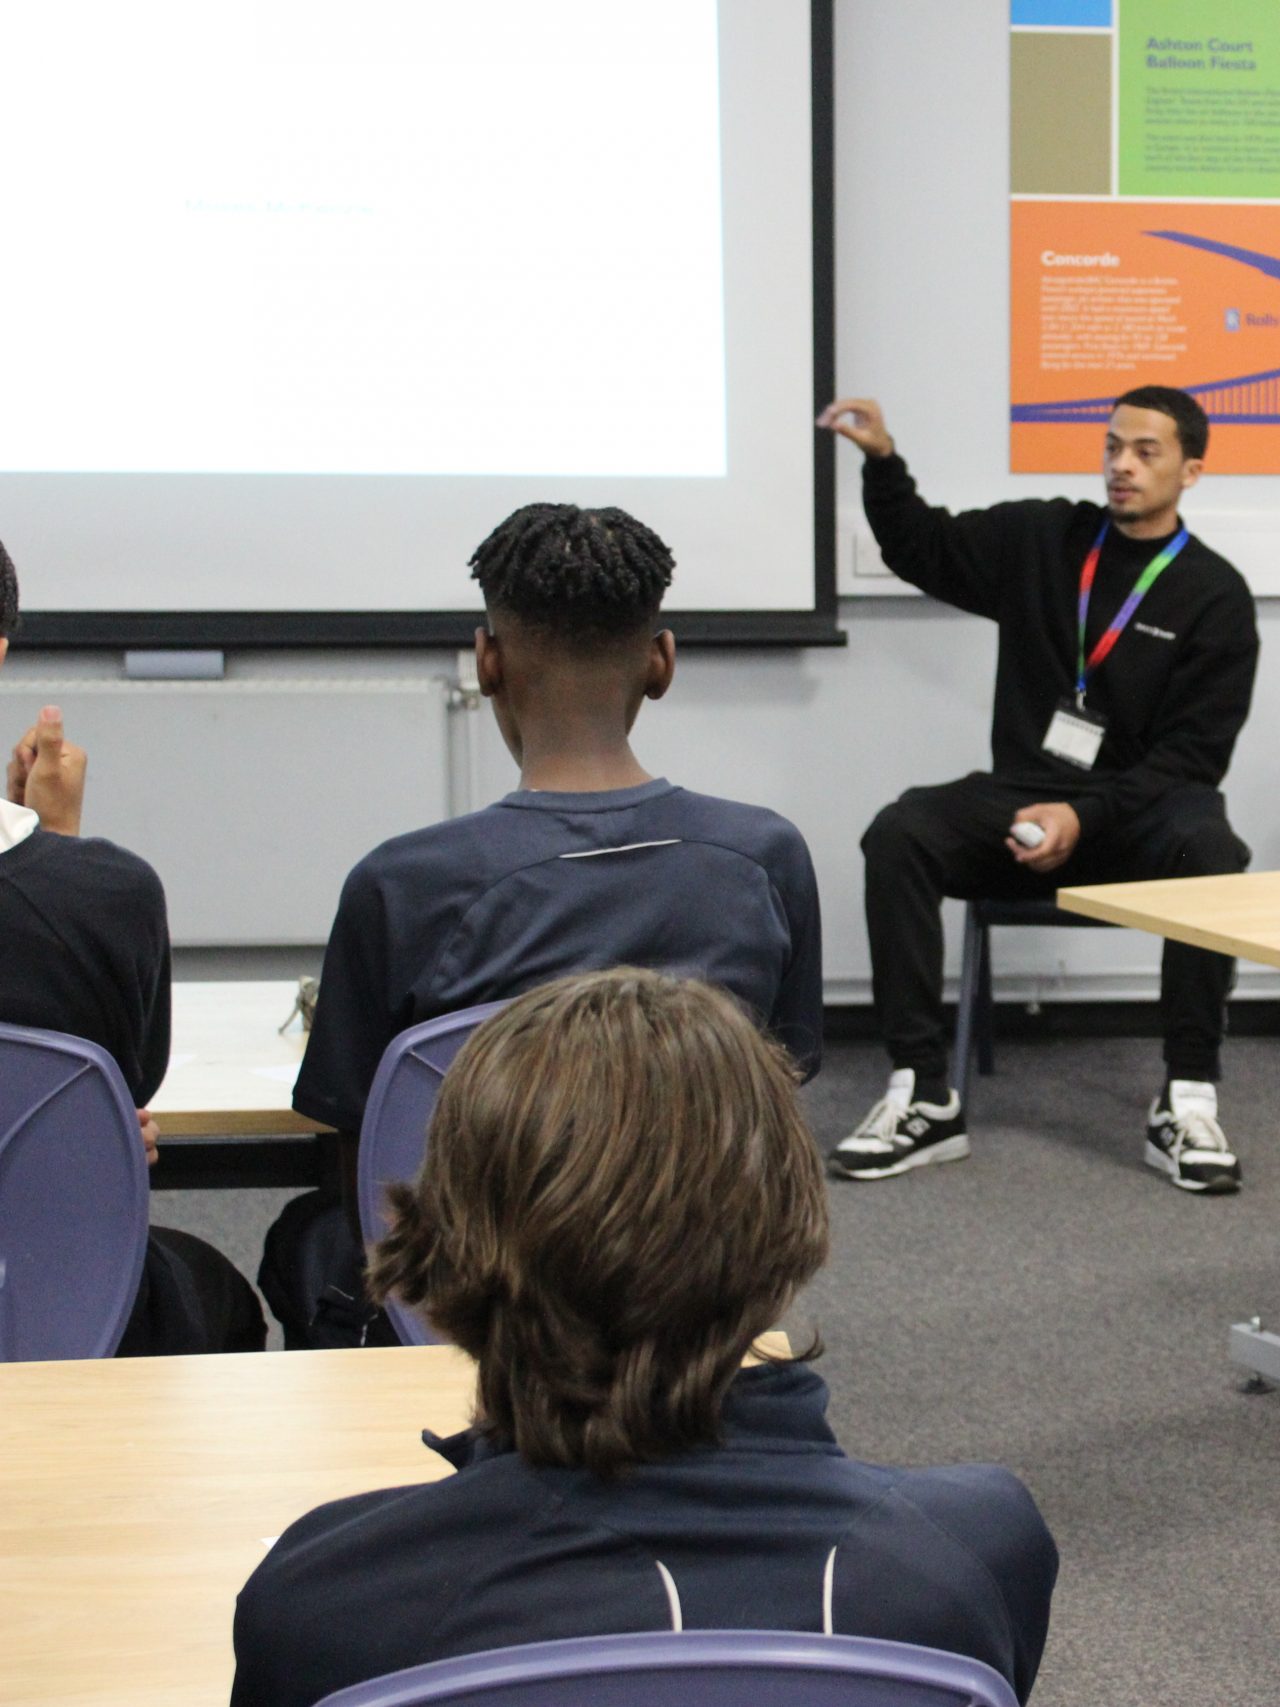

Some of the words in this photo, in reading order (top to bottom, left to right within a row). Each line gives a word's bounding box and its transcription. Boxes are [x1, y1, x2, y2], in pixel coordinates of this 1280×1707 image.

[1146, 37, 1202, 51] Ashton
[1207, 38, 1253, 53] Court
[1146, 54, 1205, 69] Balloon
[1210, 56, 1256, 71] Fiesta
[1040, 251, 1120, 267] Concorde
